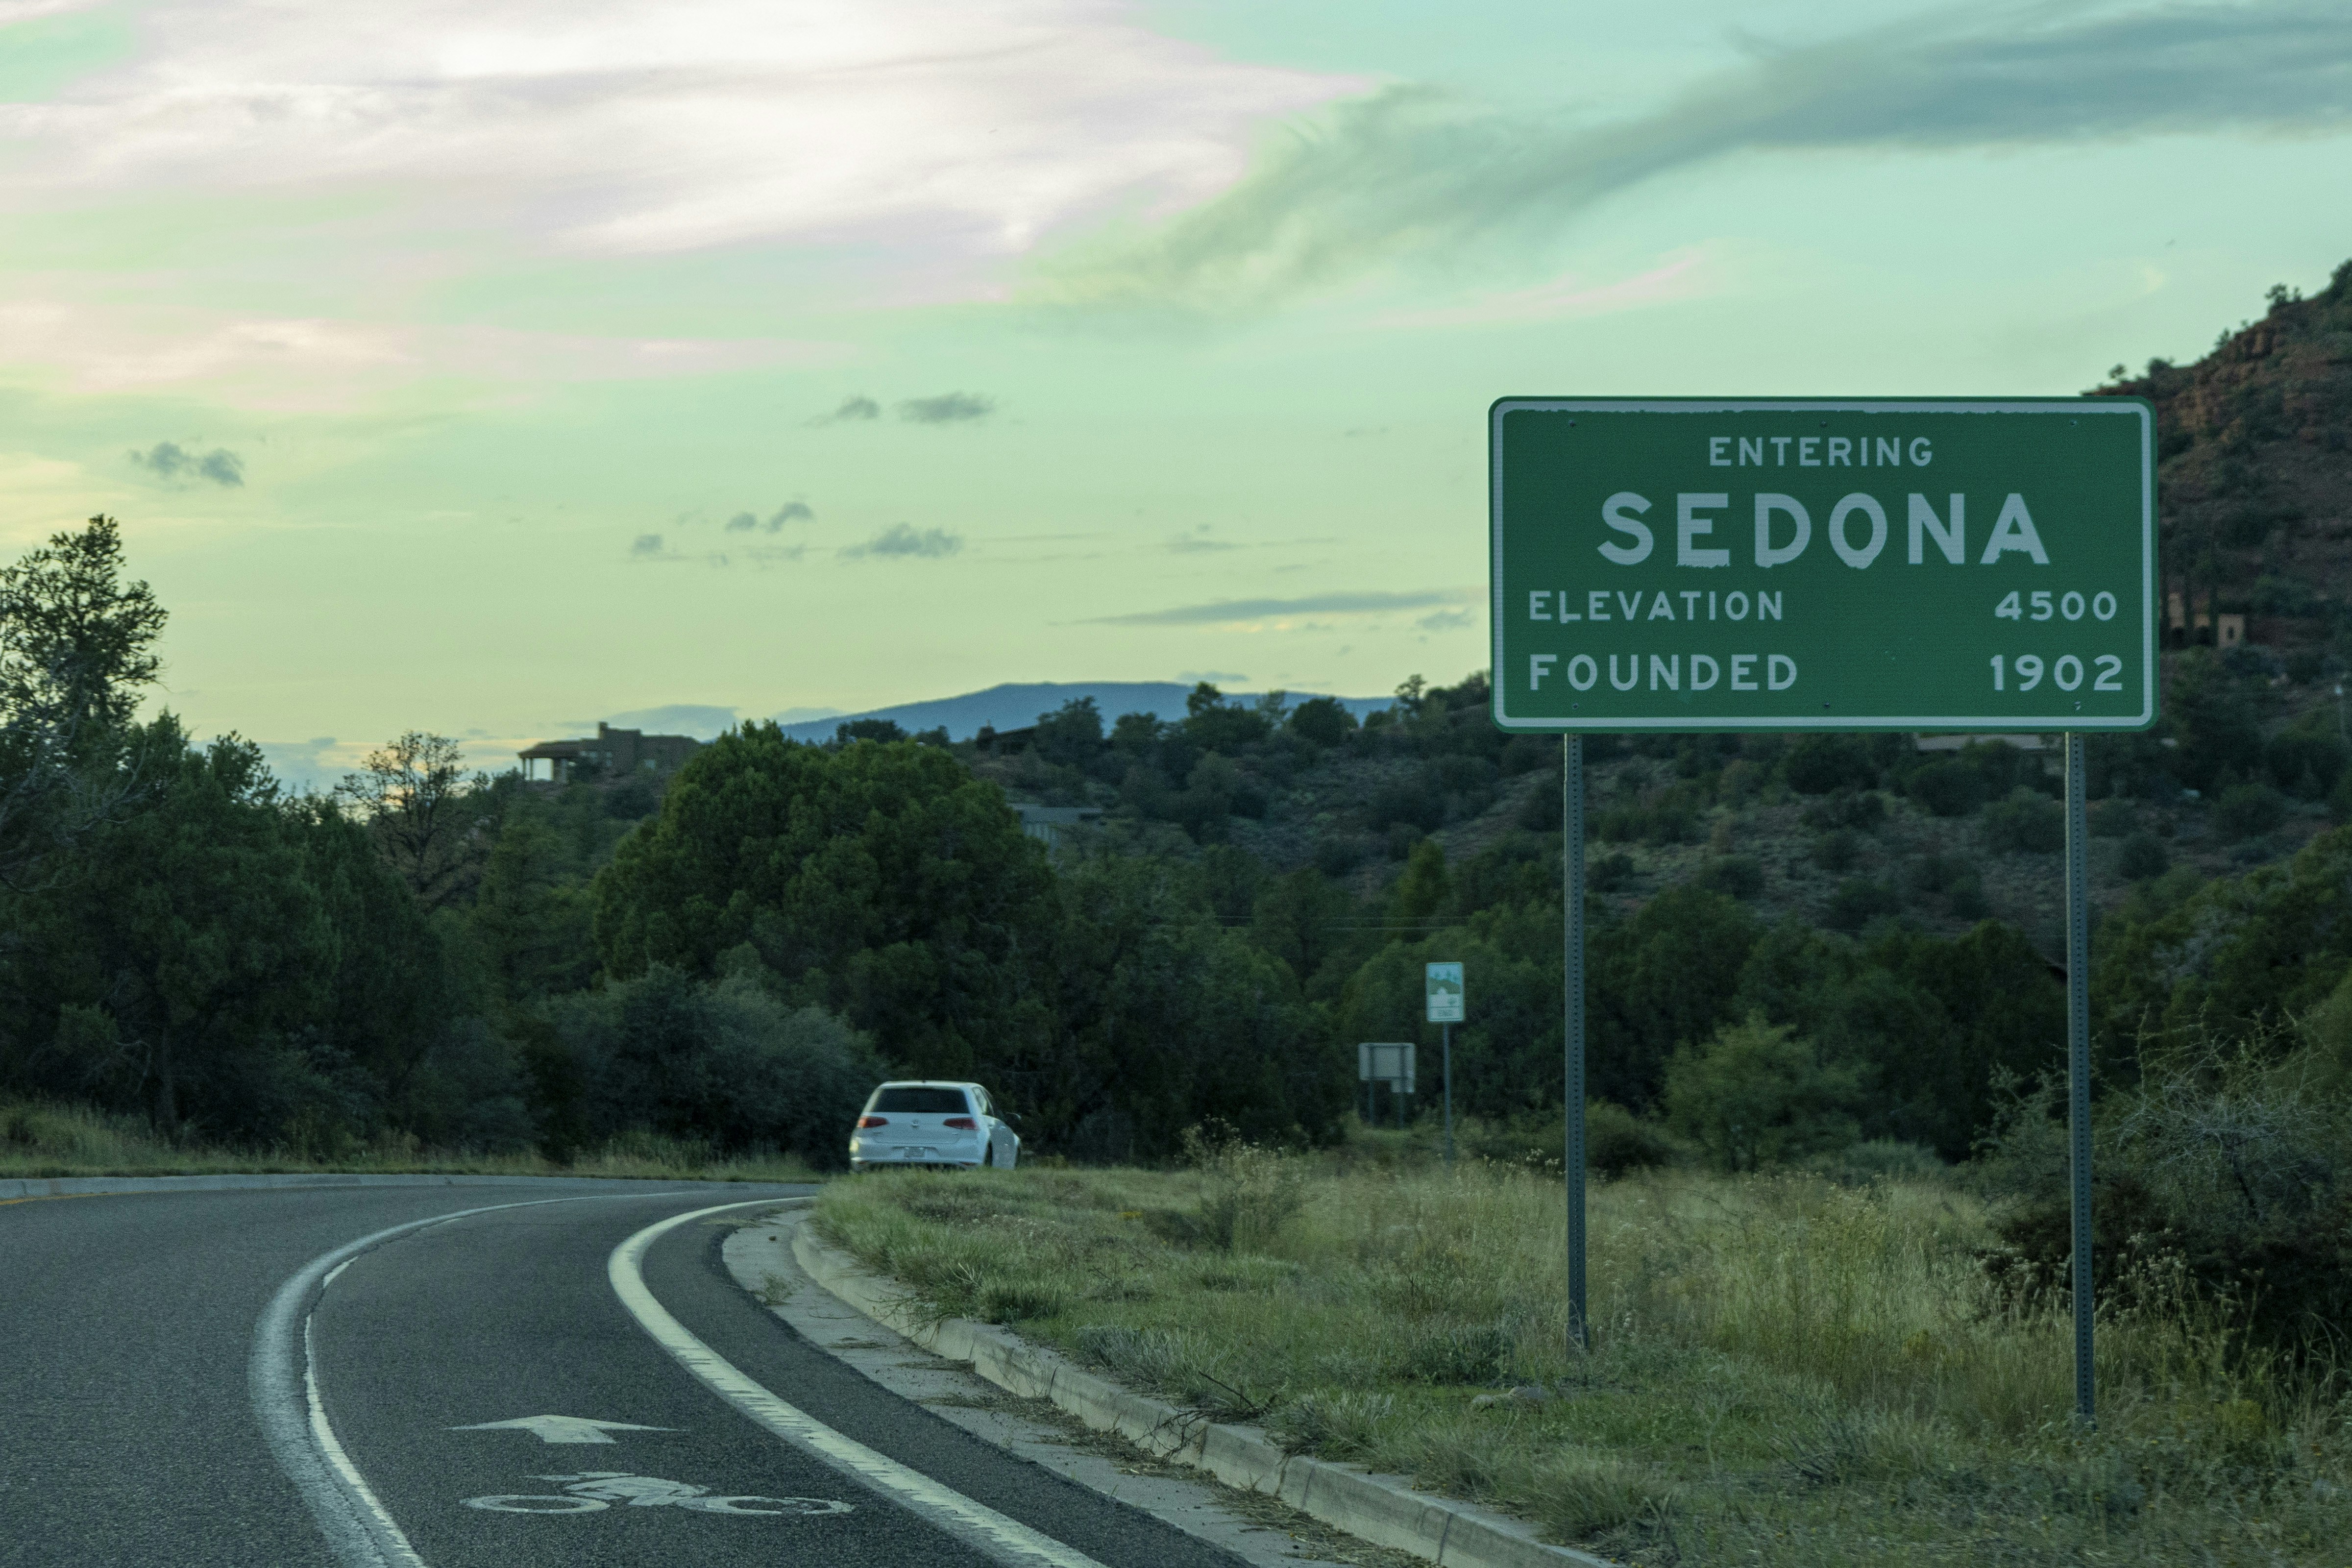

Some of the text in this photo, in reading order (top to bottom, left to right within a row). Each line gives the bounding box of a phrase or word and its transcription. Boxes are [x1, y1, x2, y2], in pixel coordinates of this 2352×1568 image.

[1710, 437, 1932, 466] ENTERING
[1598, 491, 2049, 569] SEDONA
[1530, 591, 2117, 623] ELEVATION 4500
[1531, 654, 2122, 691] FOUNDED 1902
